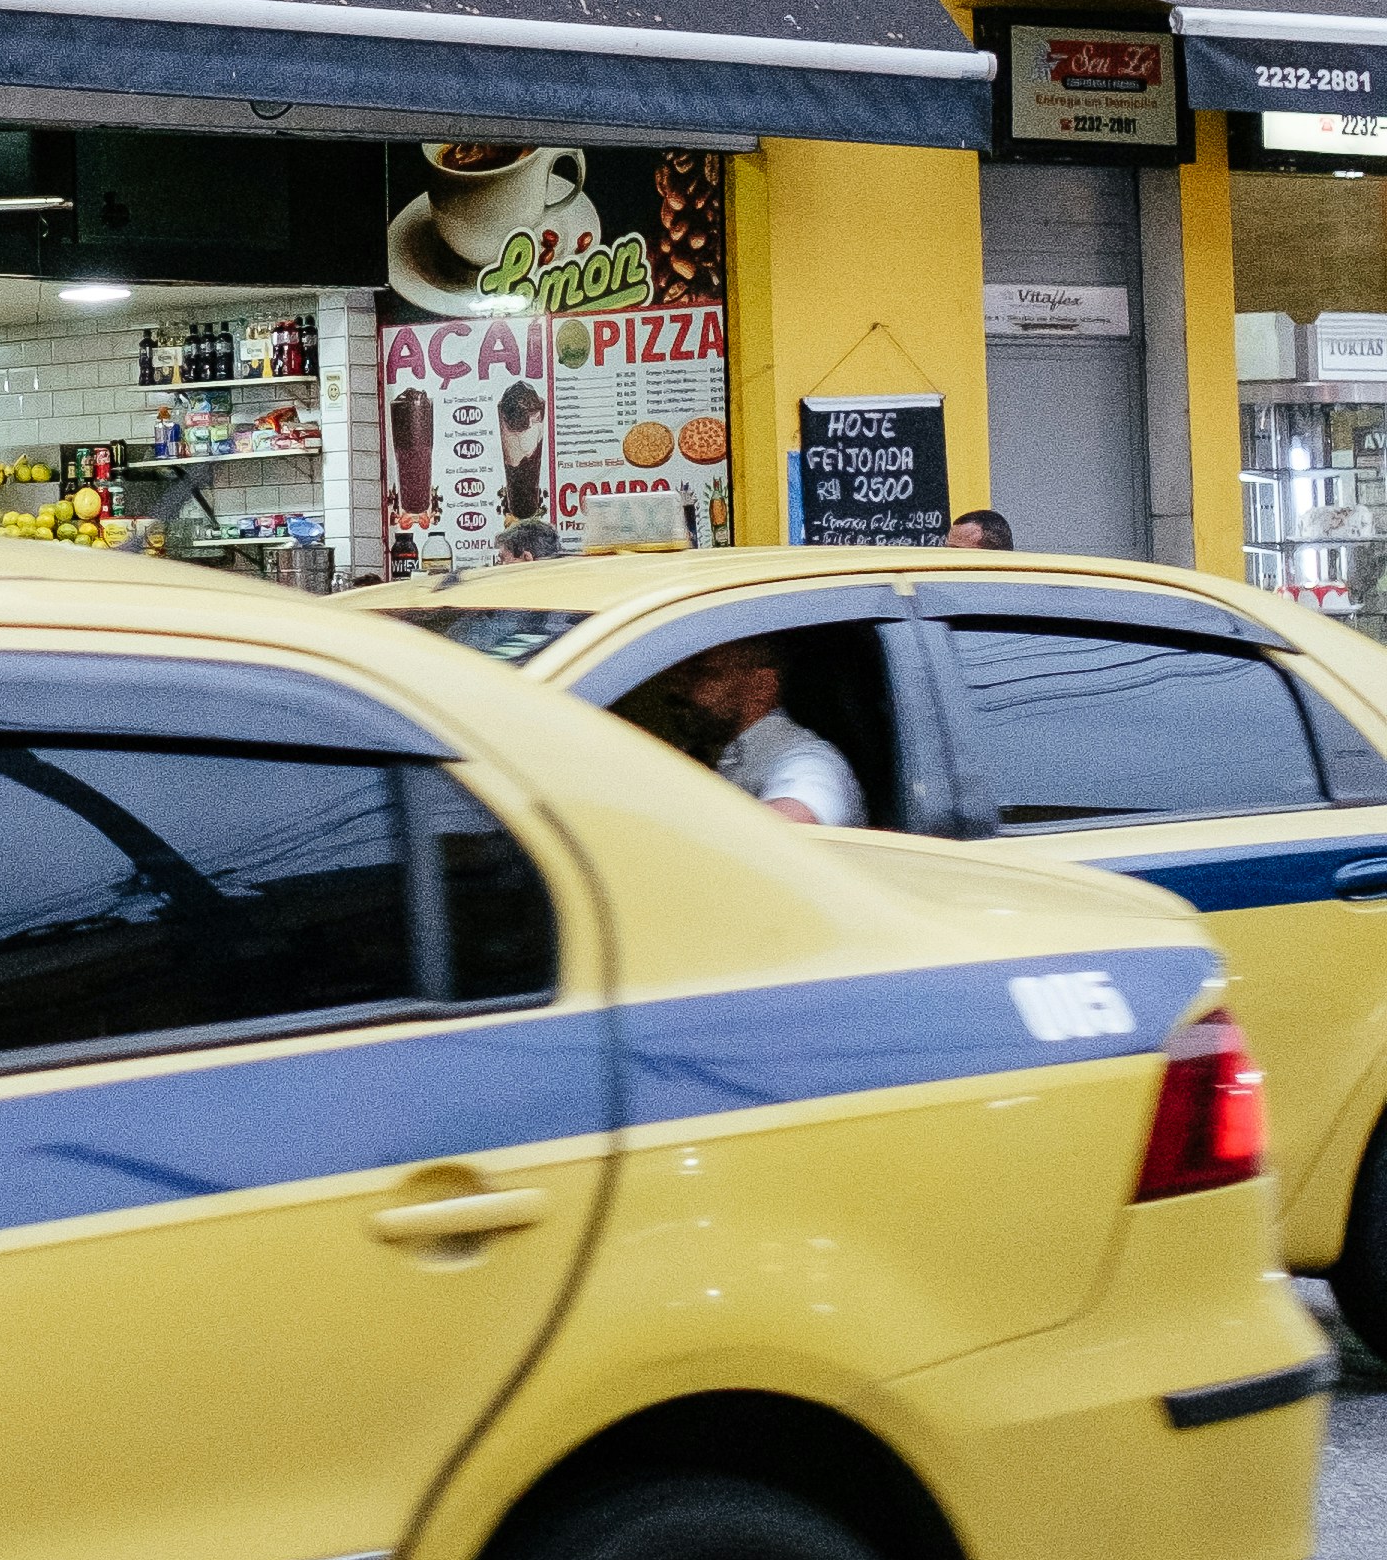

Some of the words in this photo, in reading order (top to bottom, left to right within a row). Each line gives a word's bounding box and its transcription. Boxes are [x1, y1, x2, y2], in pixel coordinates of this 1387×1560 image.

[1071, 43, 1111, 75] Seu
[1255, 65, 1371, 93] 2232-2881
[1073, 114, 1138, 135] 2232-2881
[593, 310, 724, 367] PIZZA
[1329, 338, 1384, 357] TORTAS
[386, 317, 545, 391] AÇAÍ
[454, 408, 482, 425] 10,00
[827, 412, 897, 439] HOJE
[455, 442, 483, 458] 14,00
[806, 441, 914, 473] FEIJOADA
[456, 481, 484, 496] 13,00
[458, 514, 485, 529] 15,00
[455, 539, 495, 550] COMPL
